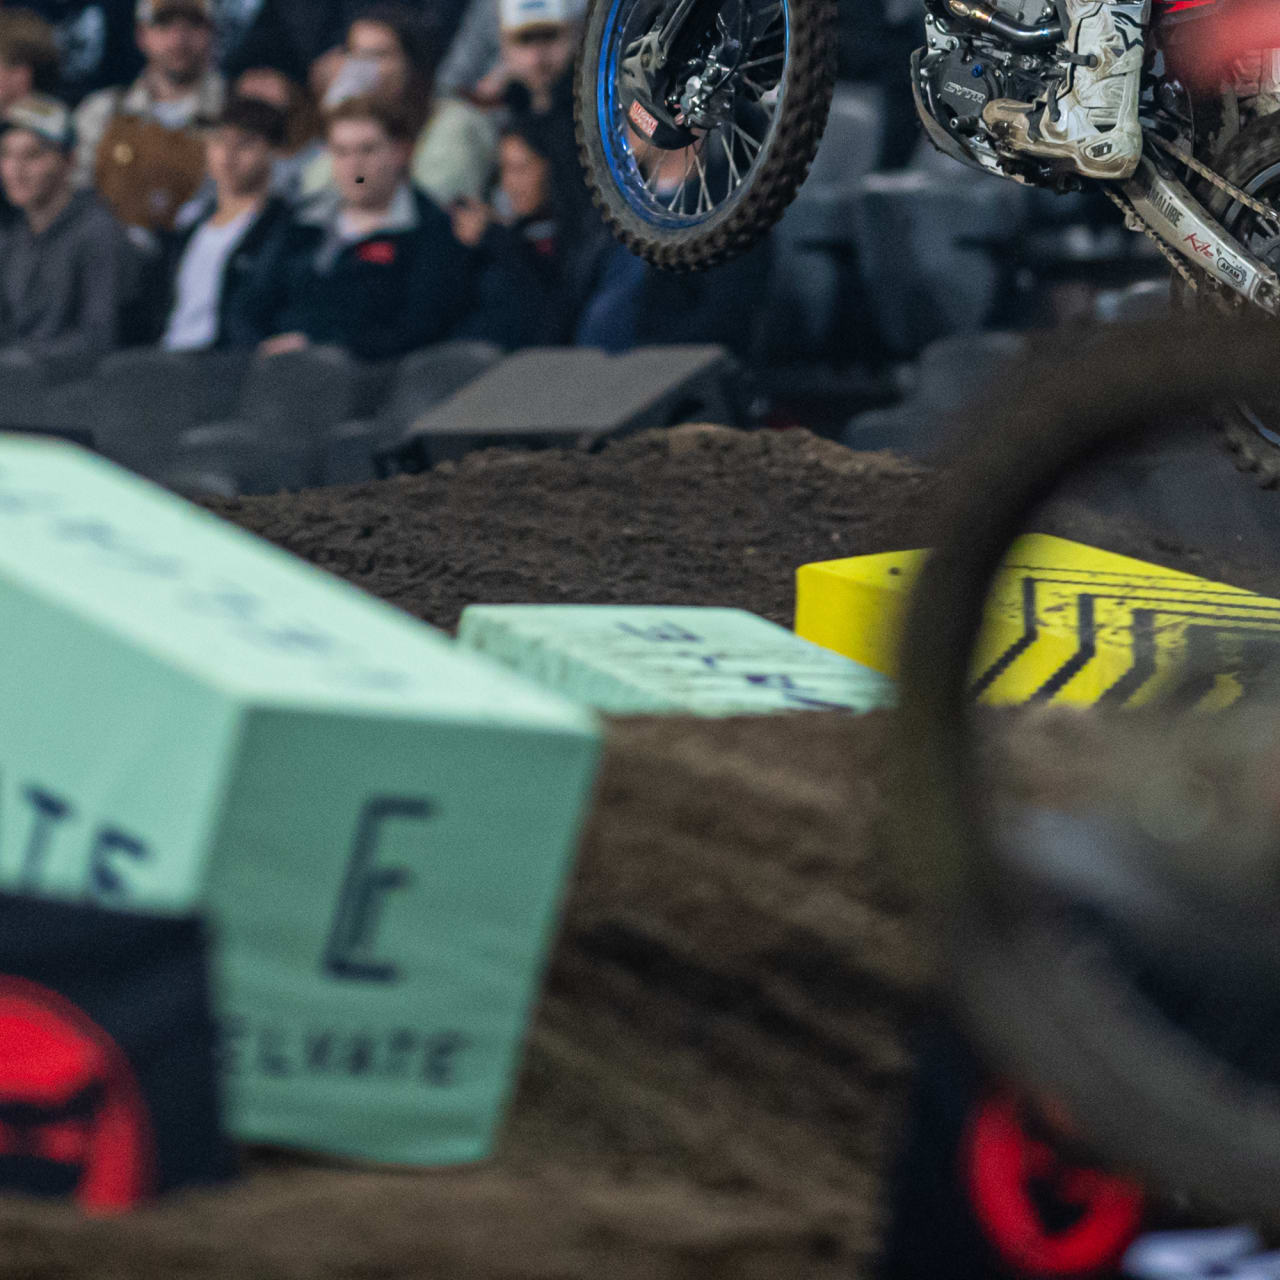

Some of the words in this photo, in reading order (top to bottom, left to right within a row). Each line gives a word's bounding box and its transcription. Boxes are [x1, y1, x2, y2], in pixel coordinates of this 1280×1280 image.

[943, 81, 986, 104] GYTR
[1145, 186, 1185, 228] MALUBE
[1220, 262, 1241, 279] AFAM
[321, 793, 442, 986] E
